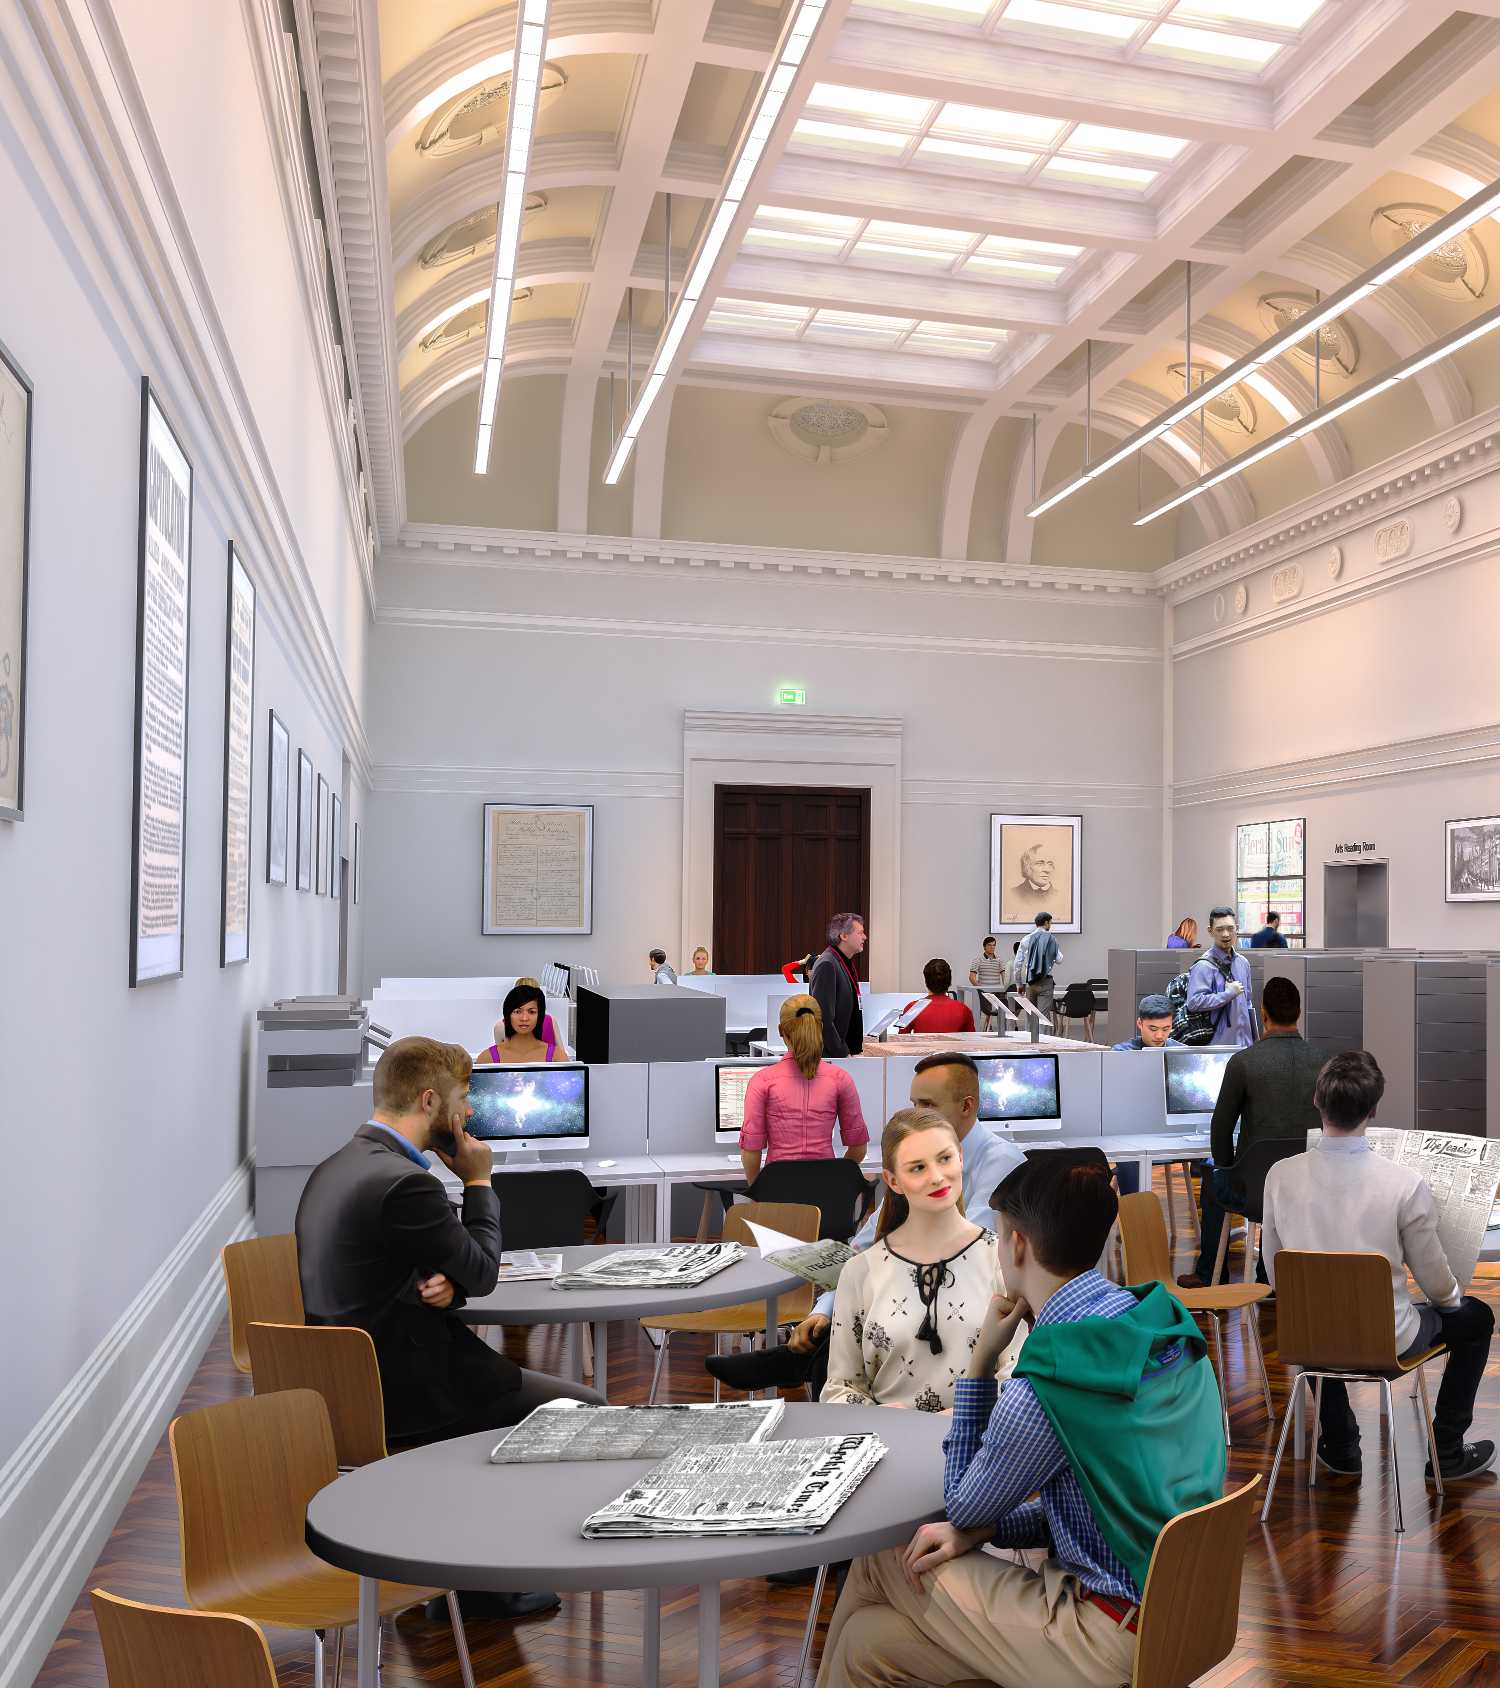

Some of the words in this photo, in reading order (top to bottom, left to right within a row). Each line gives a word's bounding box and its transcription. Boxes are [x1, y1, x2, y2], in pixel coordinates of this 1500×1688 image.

[1344, 842, 1361, 854] Reading
[1362, 841, 1376, 852] Room
[1423, 1138, 1442, 1153] The
[1435, 1141, 1477, 1158] Leader
[809, 1436, 866, 1477] Weekly
[786, 1481, 829, 1514] Times
